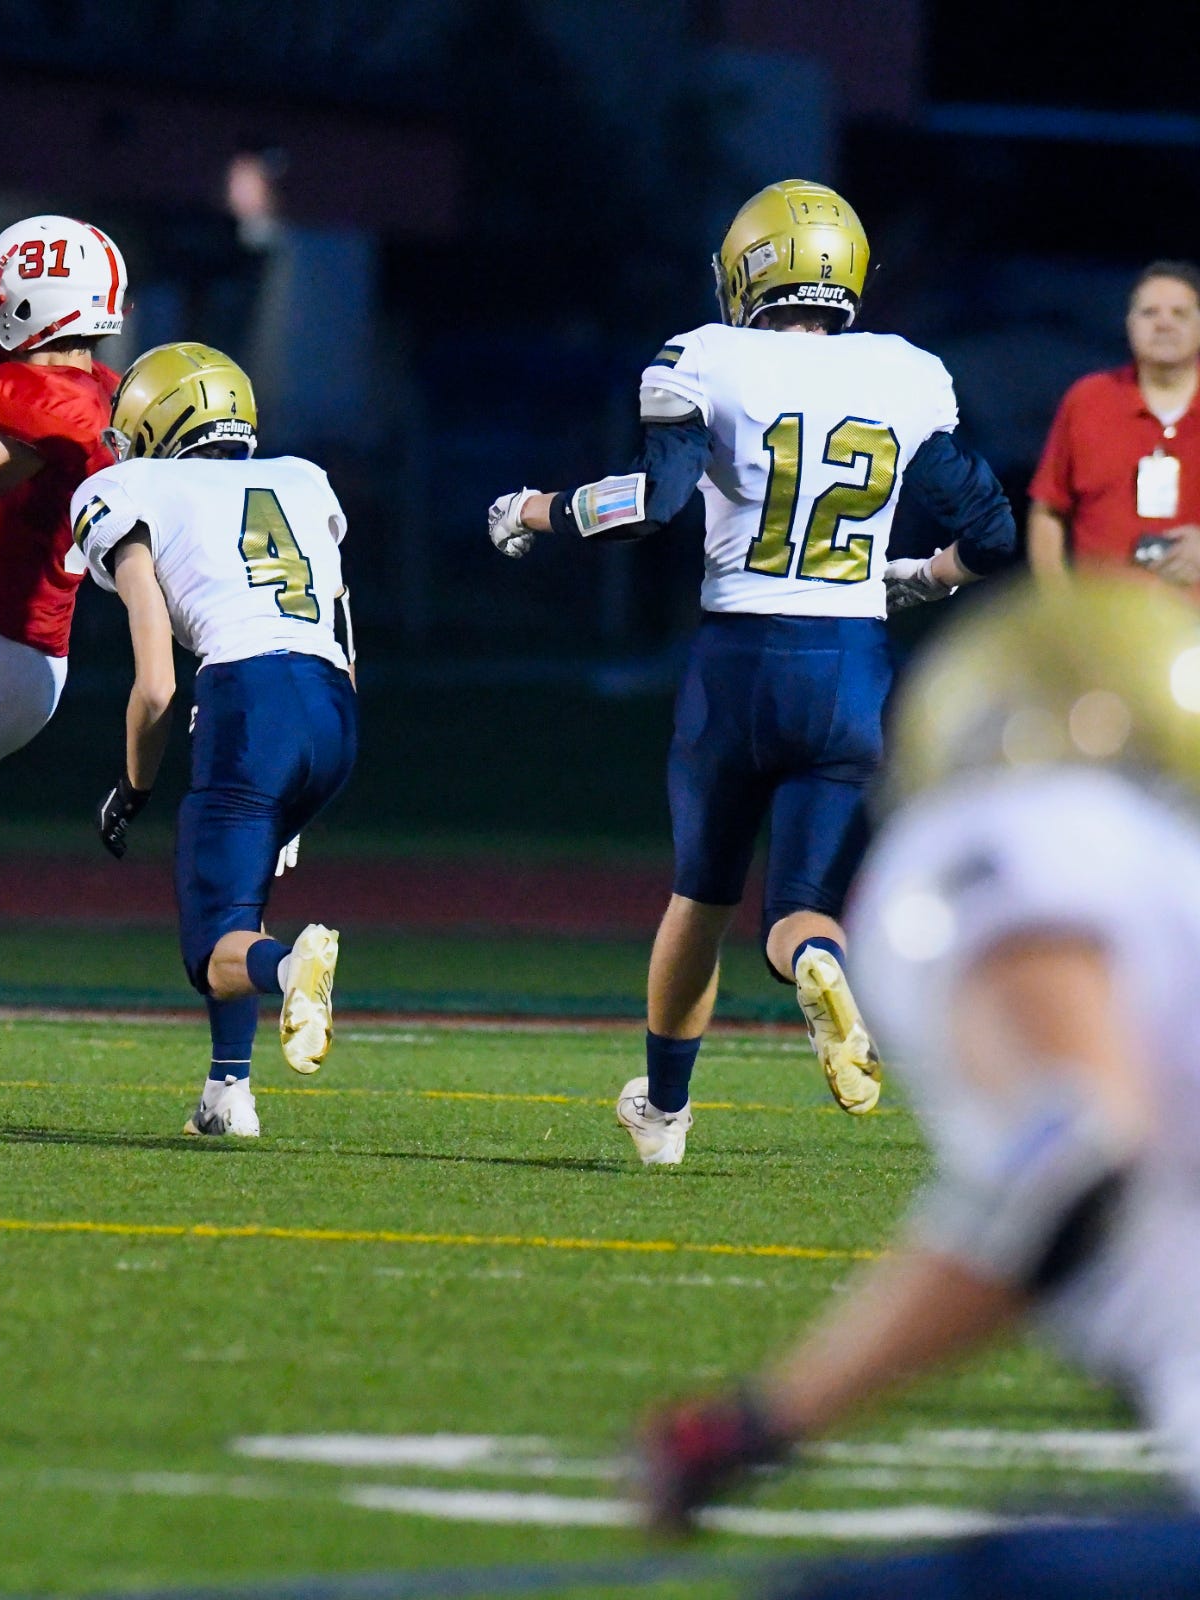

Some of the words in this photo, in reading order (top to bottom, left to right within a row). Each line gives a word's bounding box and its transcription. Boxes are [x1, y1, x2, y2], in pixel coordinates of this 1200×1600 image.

[18, 239, 70, 279] 31
[821, 265, 833, 279] 12
[796, 281, 846, 300] schutt
[230, 401, 237, 415] 4
[744, 412, 901, 585] 12
[237, 487, 321, 625] 4
